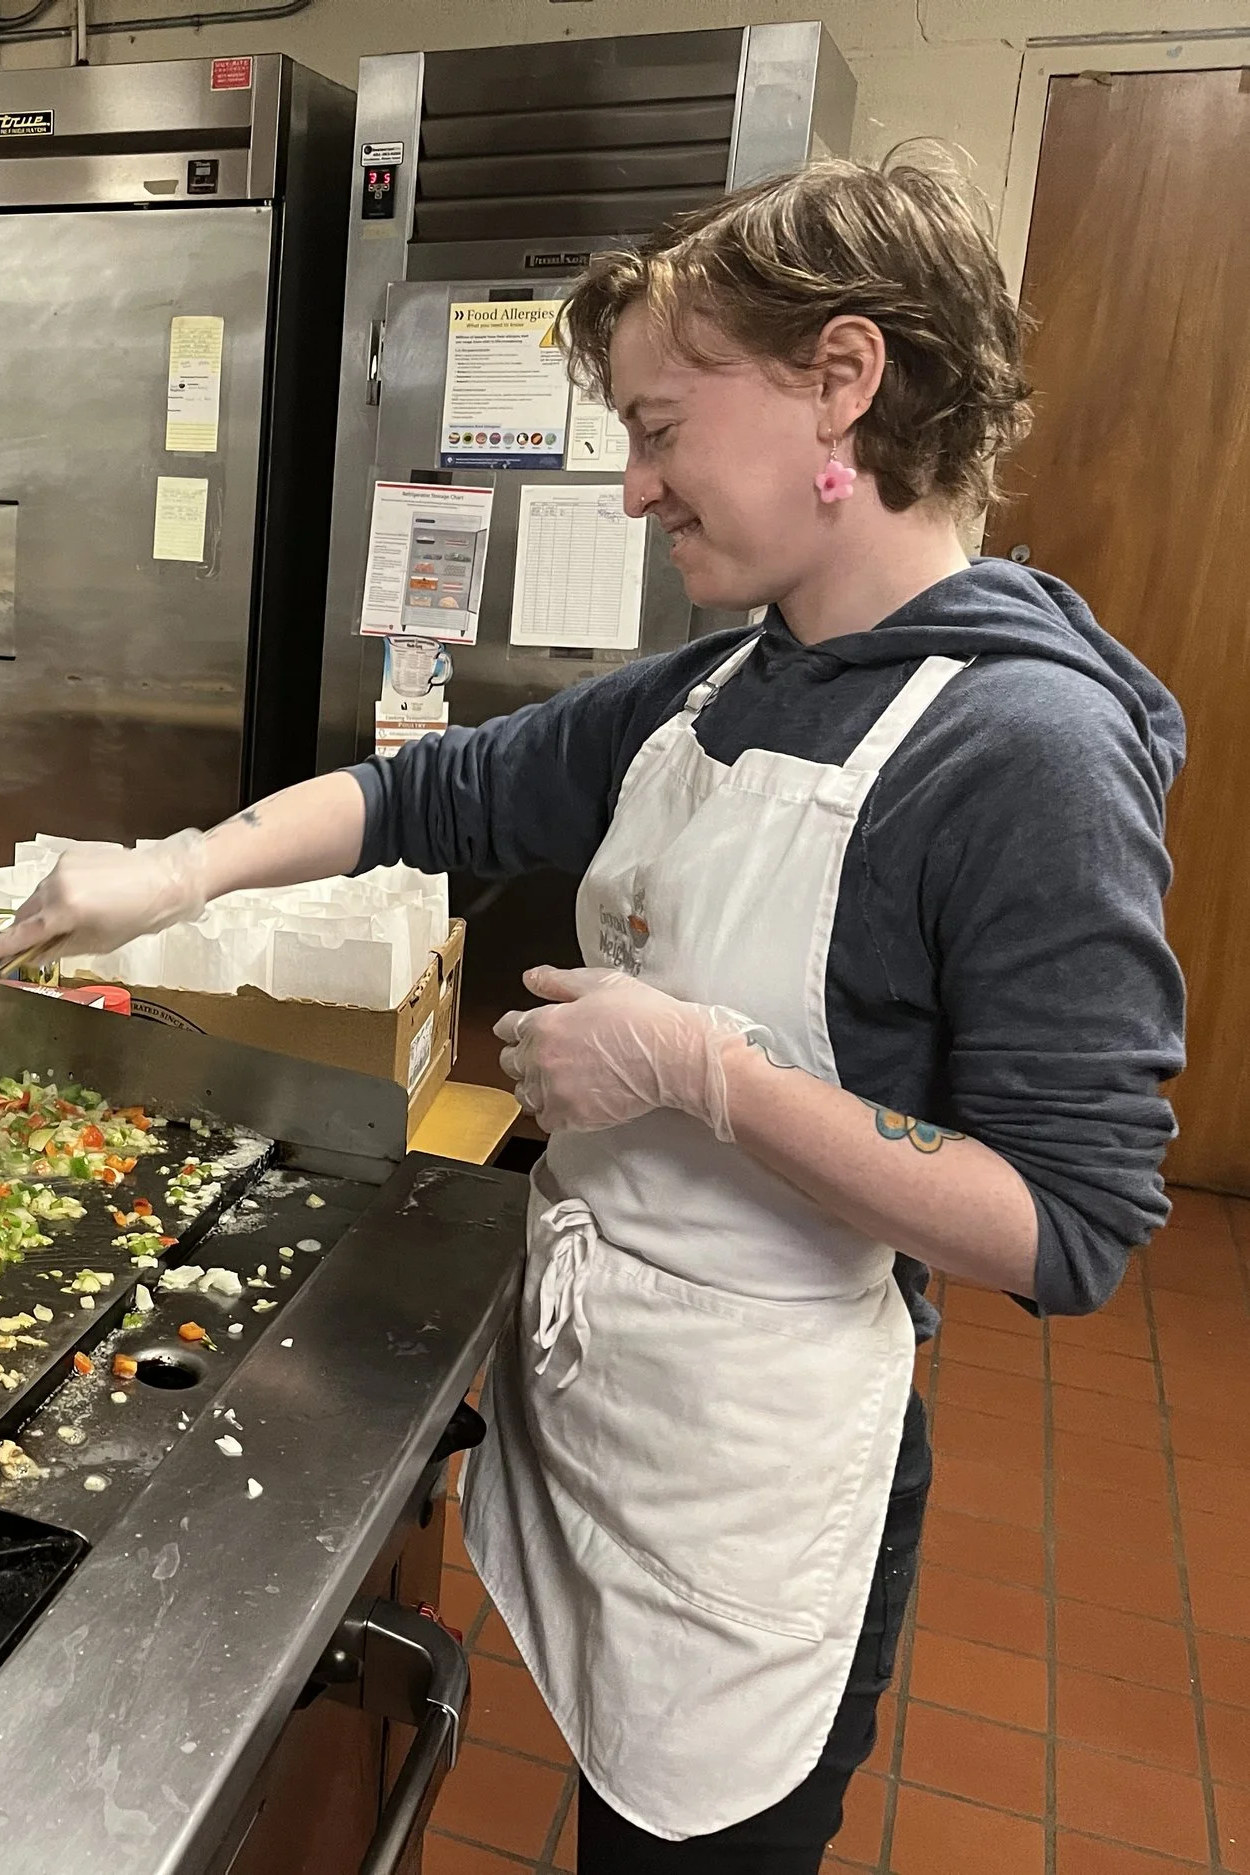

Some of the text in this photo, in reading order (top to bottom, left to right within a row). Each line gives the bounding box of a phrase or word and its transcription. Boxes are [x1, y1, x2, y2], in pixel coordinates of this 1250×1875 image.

[467, 307, 555, 323] Food Allergies
[133, 1003, 185, 1028] RATED SINCE
